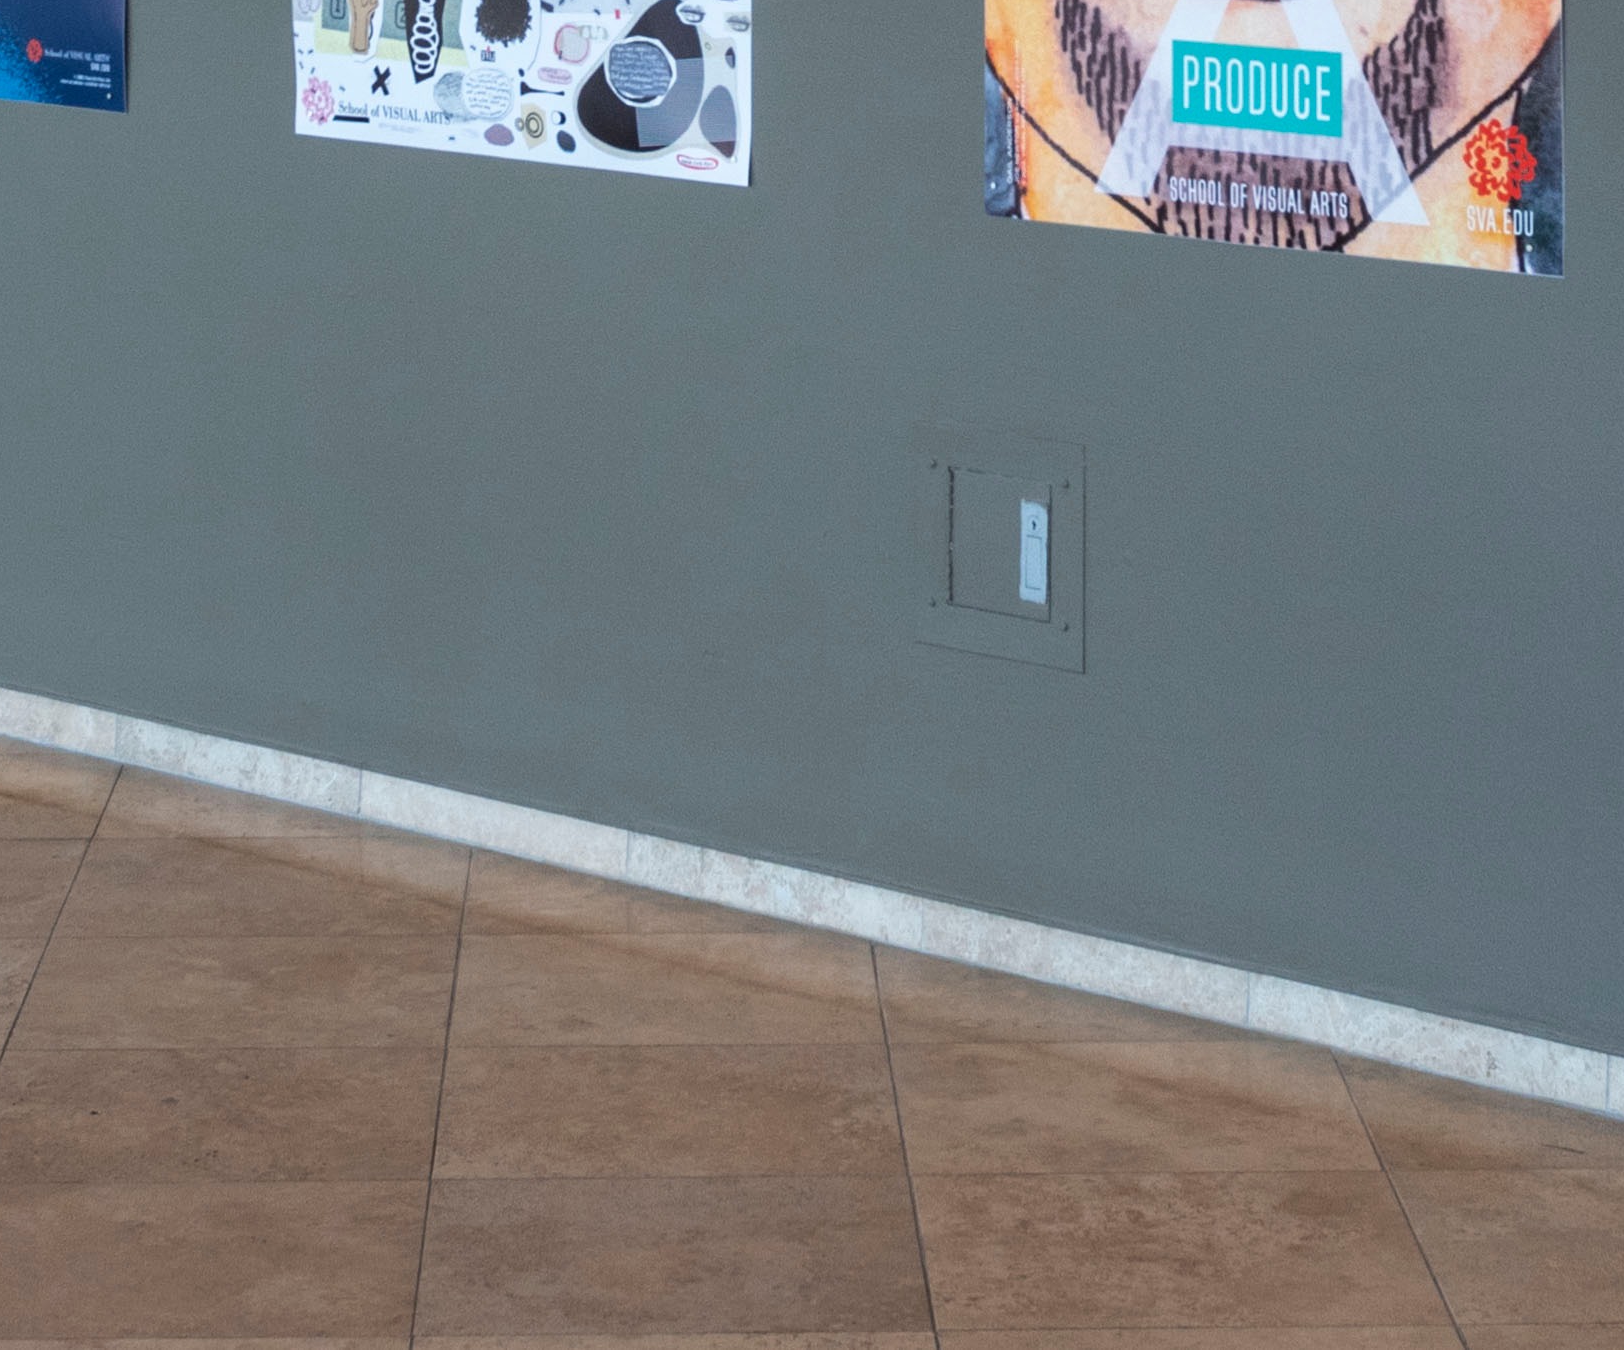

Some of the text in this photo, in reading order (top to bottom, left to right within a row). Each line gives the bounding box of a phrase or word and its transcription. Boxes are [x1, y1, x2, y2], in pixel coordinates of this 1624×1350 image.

[1182, 54, 1332, 123] PRODUCE
[339, 101, 451, 125] School of VISUAL ARTS
[1169, 176, 1348, 219] SCHOOL OF VISUAL ARTS
[1466, 205, 1535, 237] SVA.EDU
